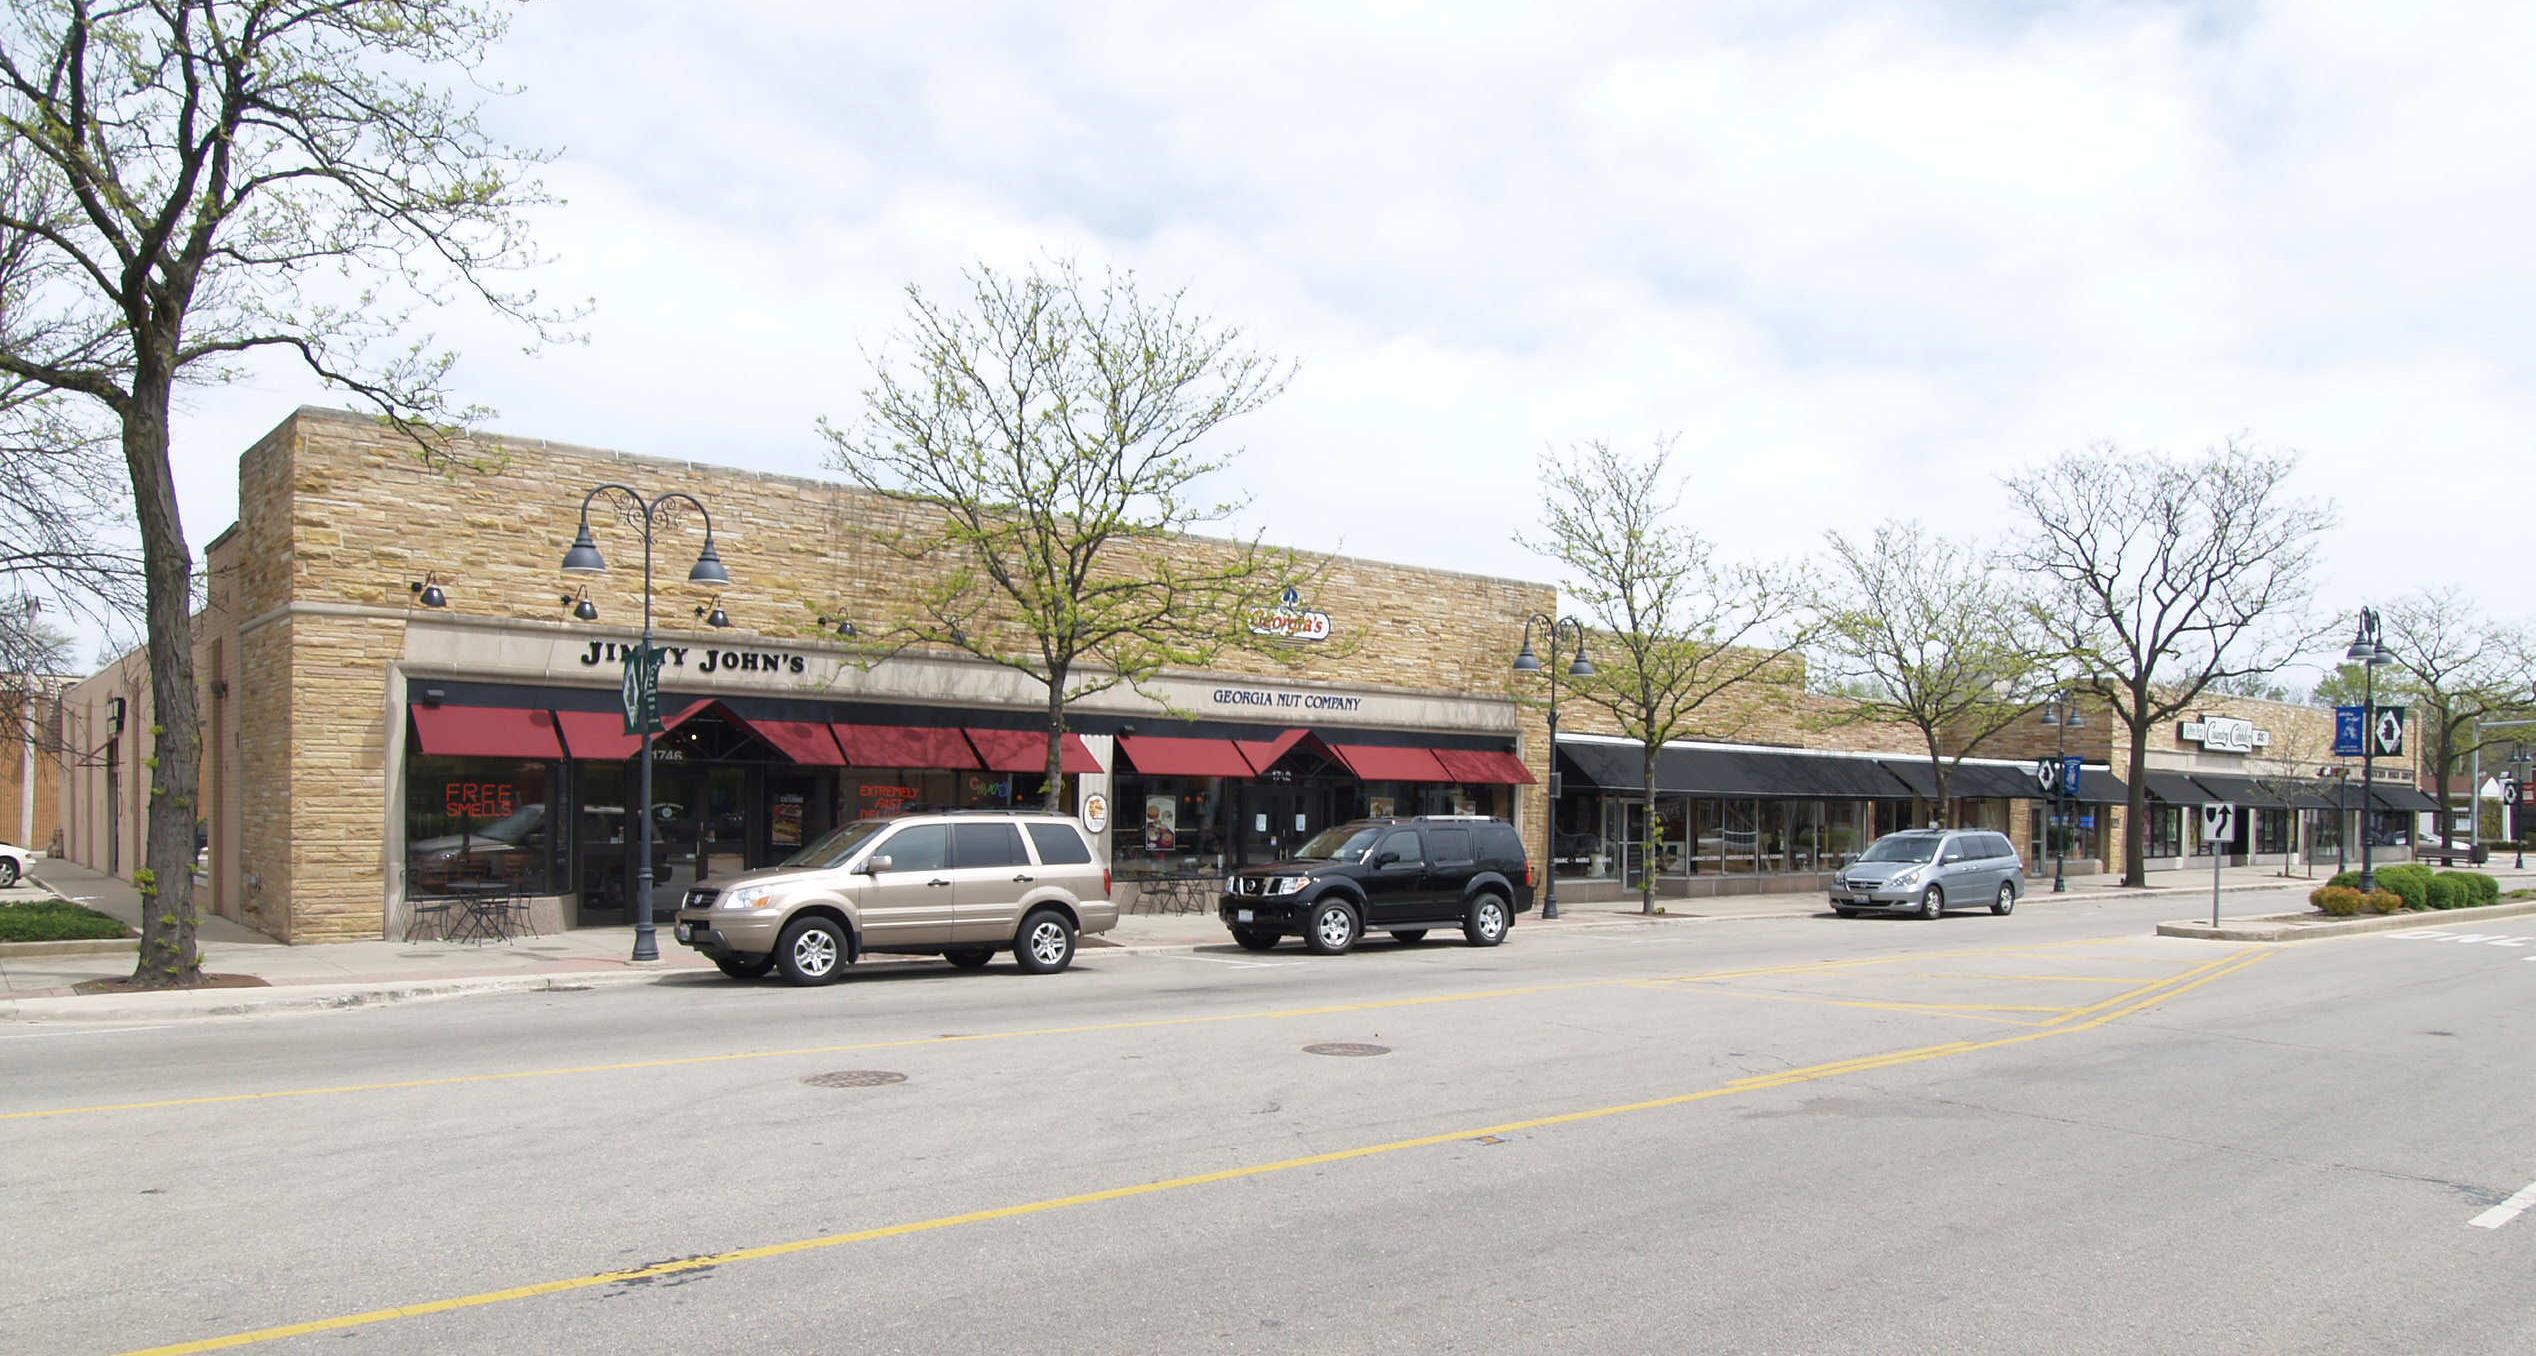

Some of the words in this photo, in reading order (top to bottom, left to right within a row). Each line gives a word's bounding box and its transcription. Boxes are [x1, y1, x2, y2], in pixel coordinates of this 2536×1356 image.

[581, 641, 689, 666] JIMY
[699, 650, 805, 673] JOHN'S
[1213, 690, 1273, 706] GEORGIA
[1277, 693, 1302, 708] NUT
[1305, 695, 1361, 711] COMPANY
[651, 750, 683, 761] 1746
[446, 783, 513, 802] FREE
[447, 801, 513, 817] SMELLS
